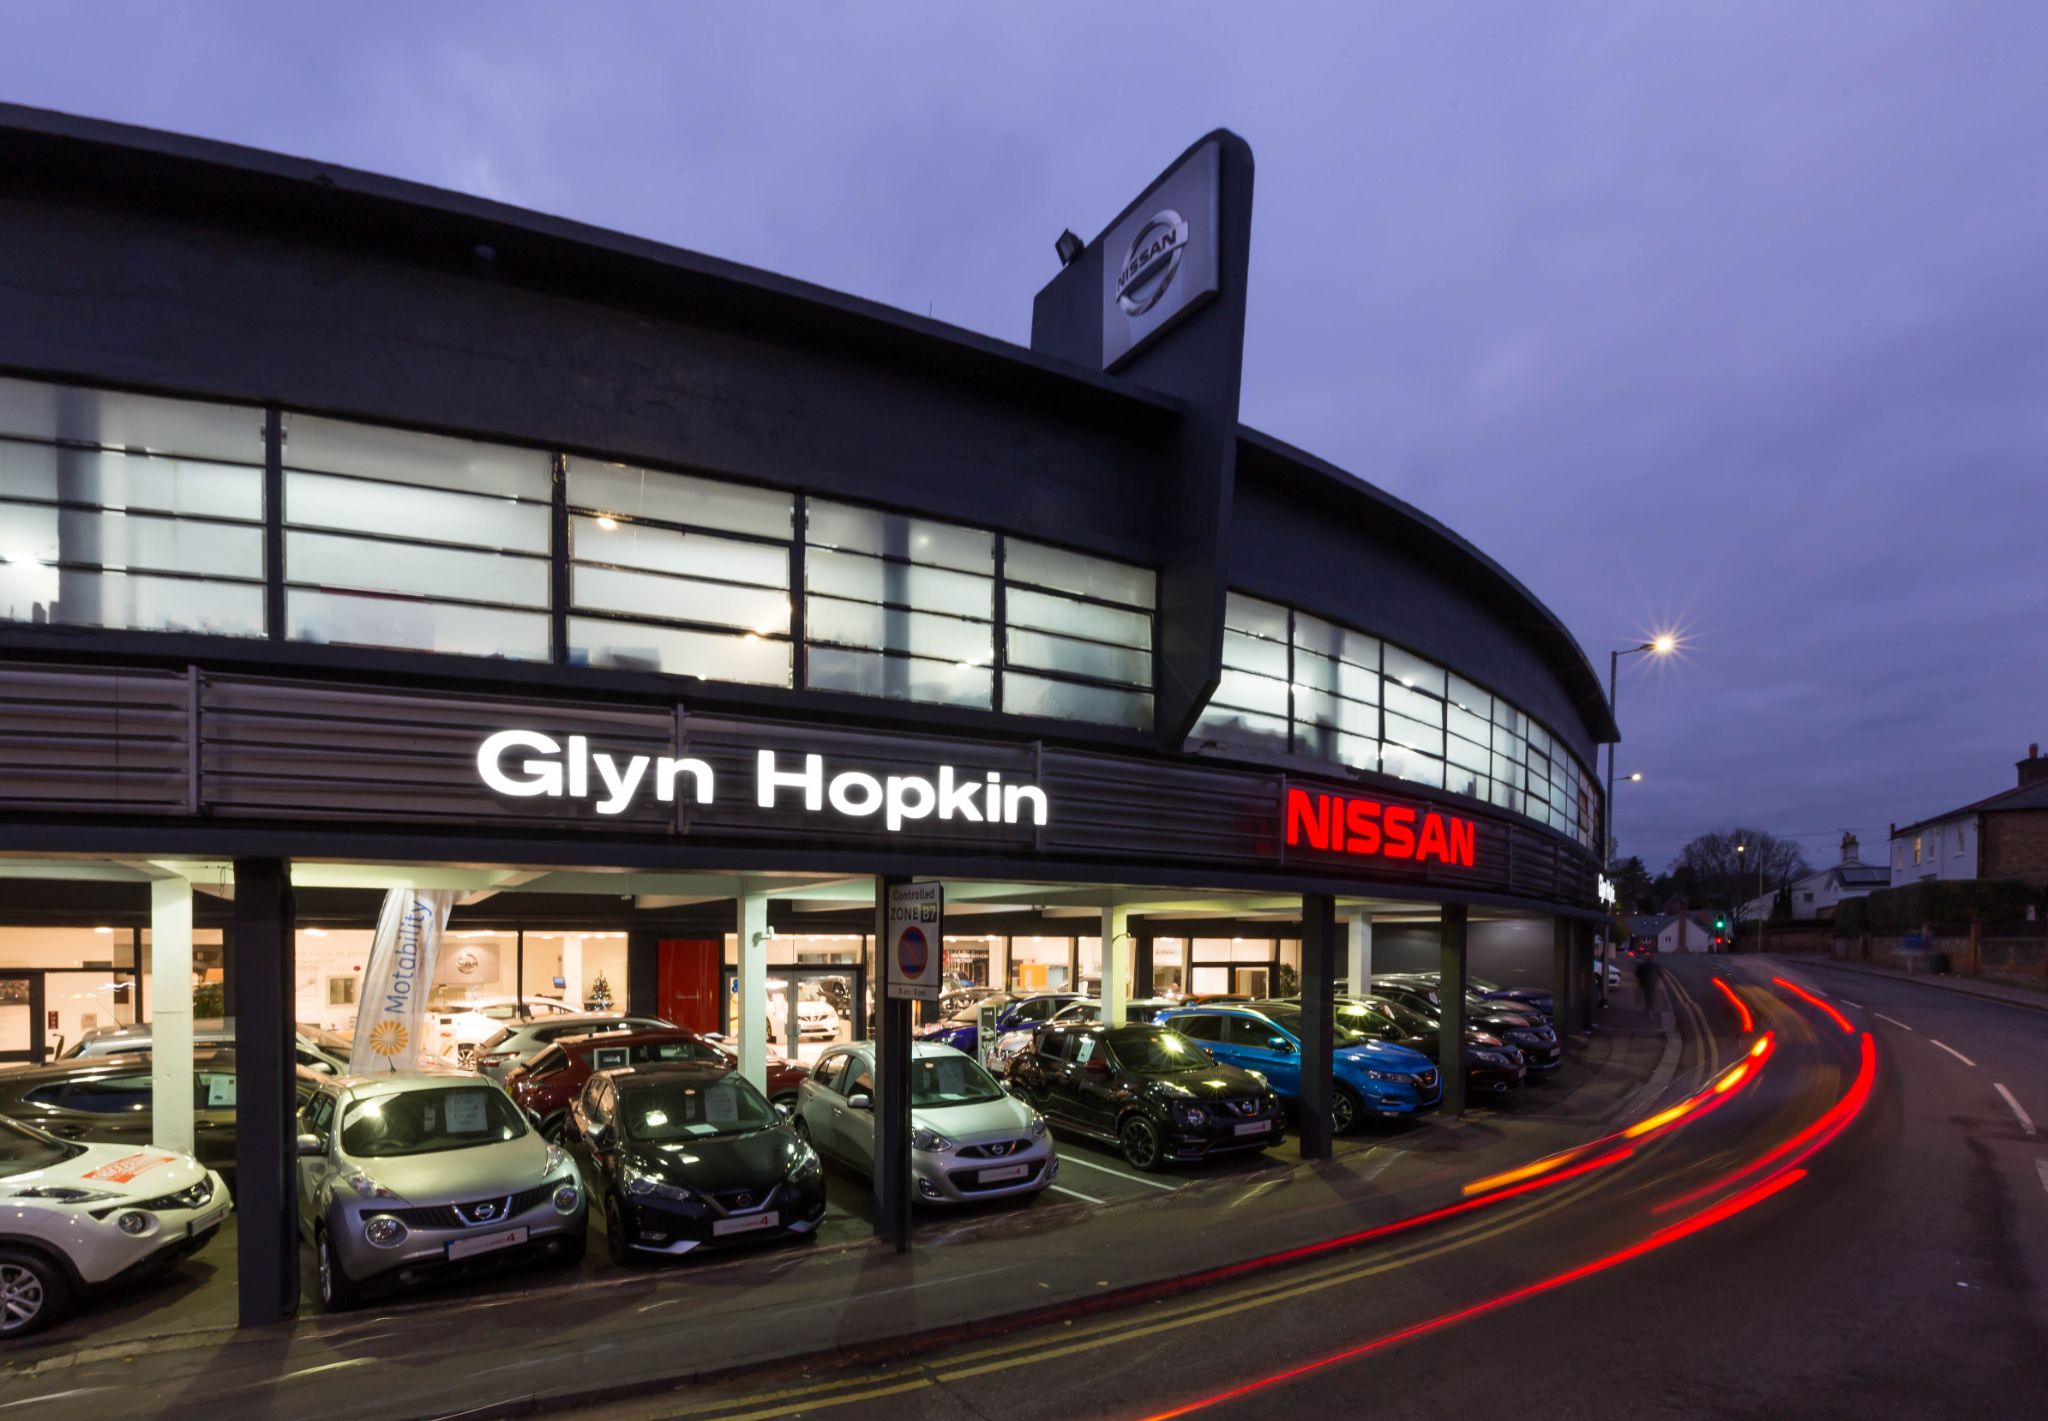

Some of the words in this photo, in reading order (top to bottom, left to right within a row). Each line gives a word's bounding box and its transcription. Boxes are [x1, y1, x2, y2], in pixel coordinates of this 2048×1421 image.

[1116, 228, 1177, 293] NISSAN
[477, 729, 714, 814] Glyn
[757, 749, 1048, 831] Hopkin
[1286, 787, 1475, 868] NISSAN
[890, 905, 919, 920] ZONE
[892, 888, 935, 901] Controlled
[384, 900, 432, 1014] Motability
